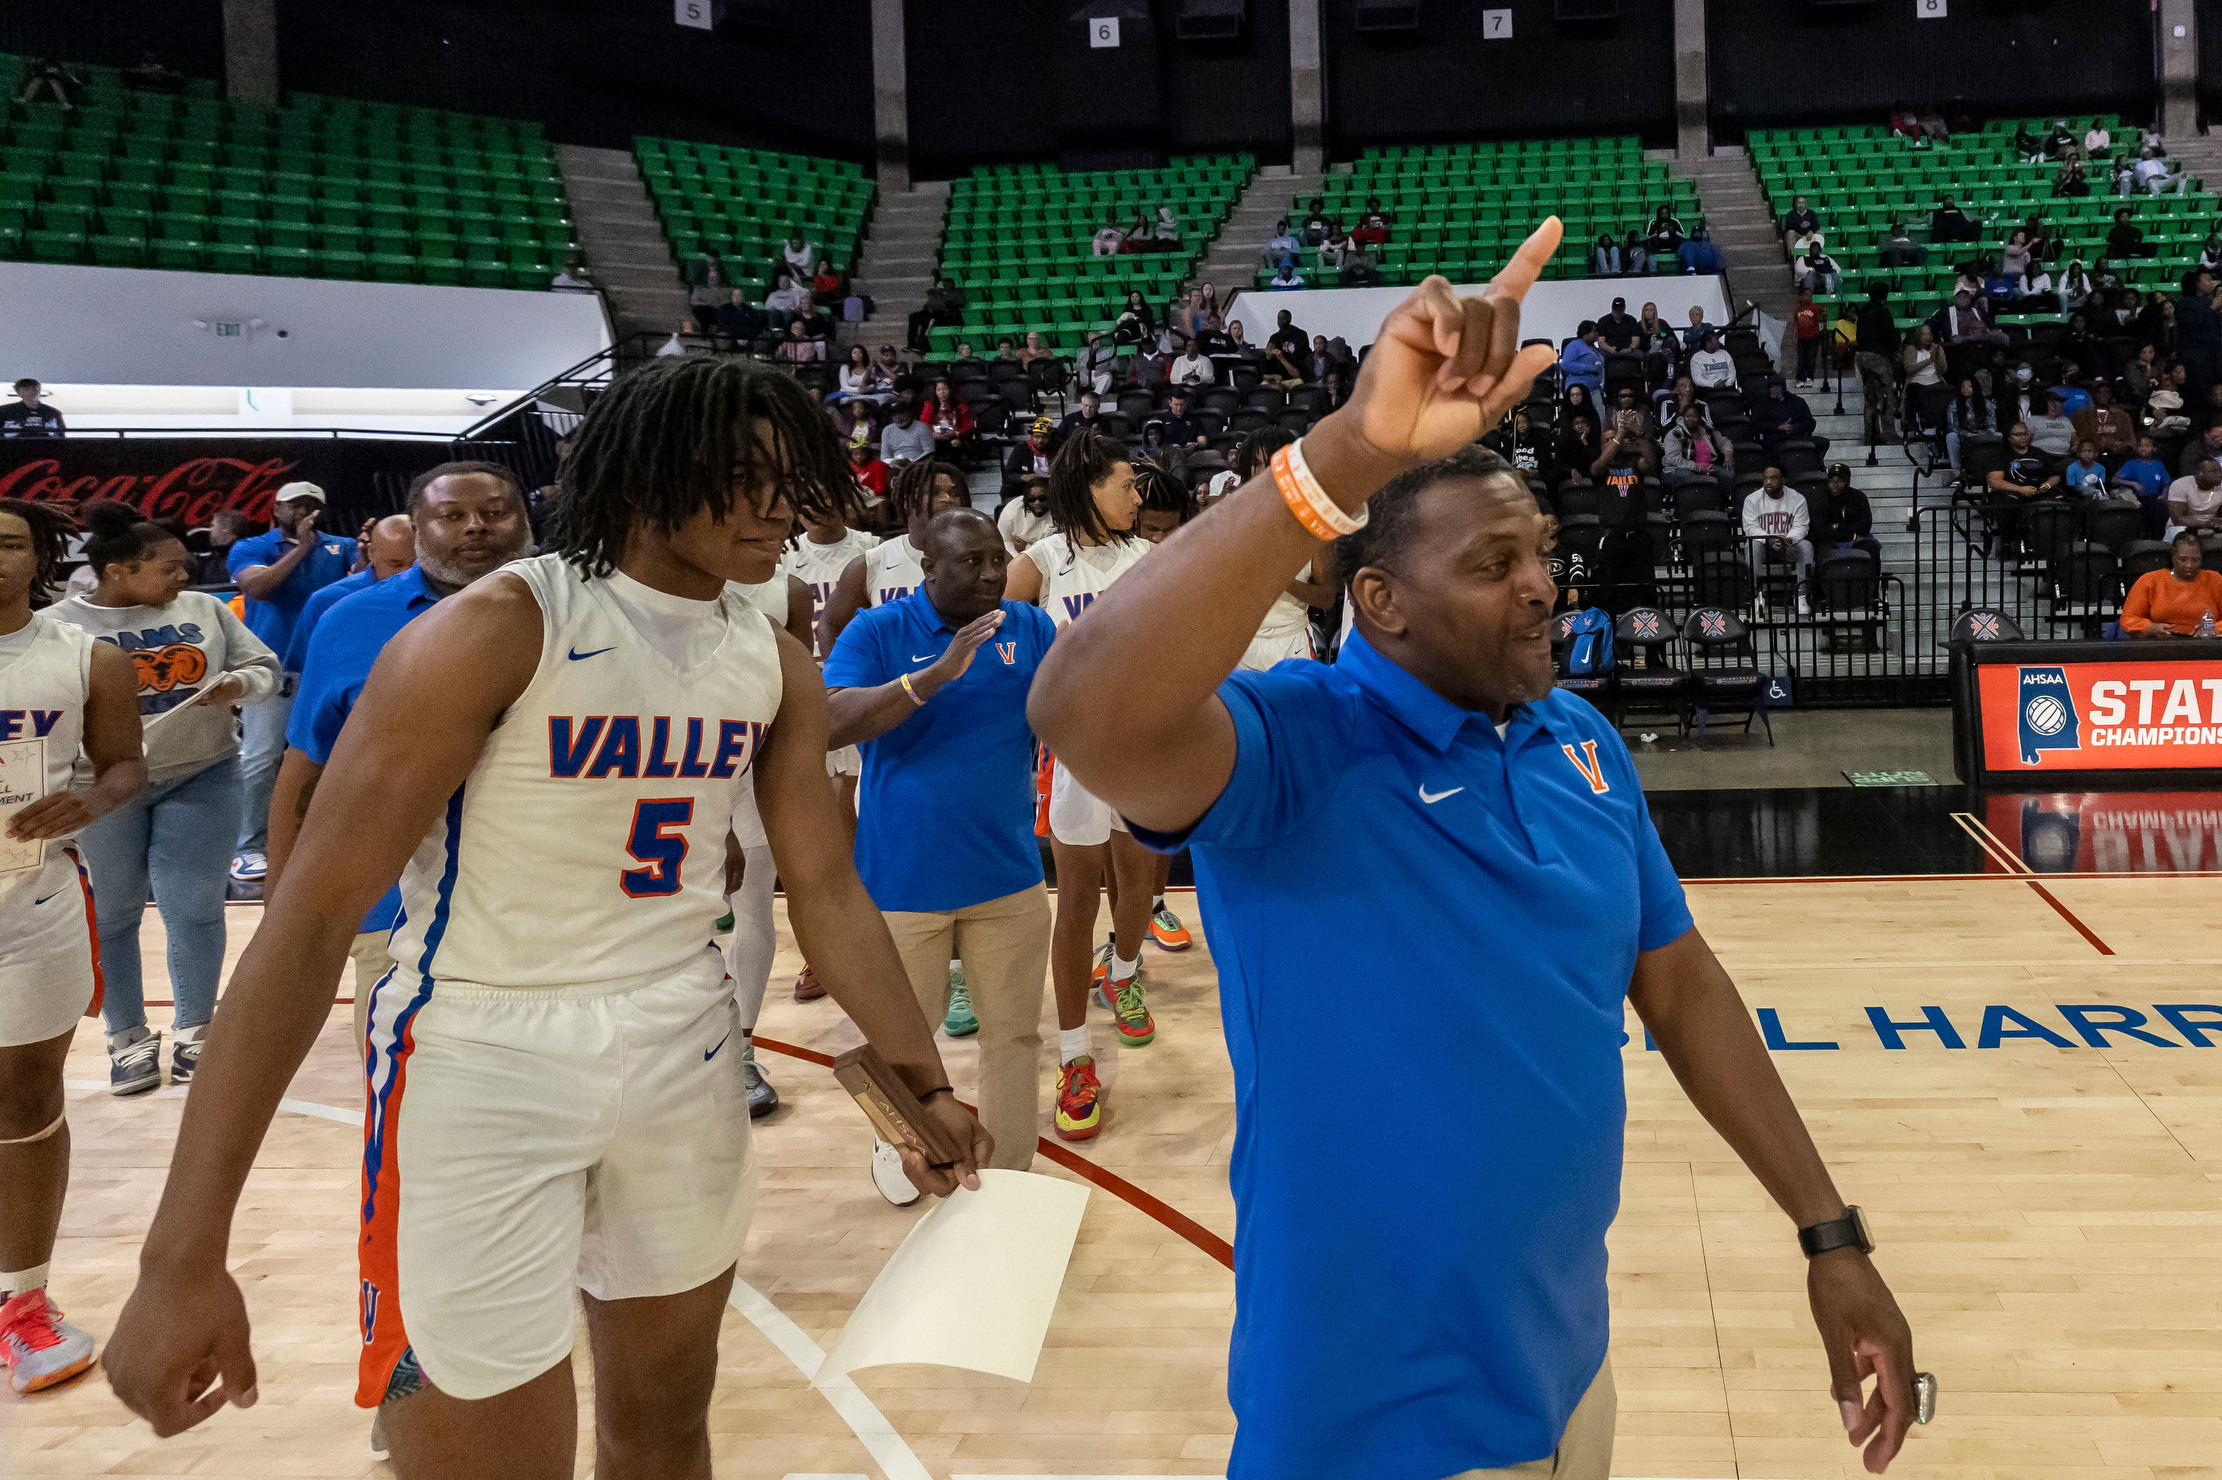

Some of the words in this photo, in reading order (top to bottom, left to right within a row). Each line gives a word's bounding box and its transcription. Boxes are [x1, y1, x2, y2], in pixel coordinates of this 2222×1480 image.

[687, 3, 700, 20] 5
[1926, 0, 1938, 10] 8
[1492, 16, 1503, 31] 7
[1098, 24, 1111, 40] 6
[216, 322, 241, 337] EXIT
[97, 622, 206, 651] AMS
[995, 641, 1017, 665] V
[2022, 674, 2064, 685] AHSAA
[1561, 738, 1610, 795] V
[619, 796, 695, 899] 5
